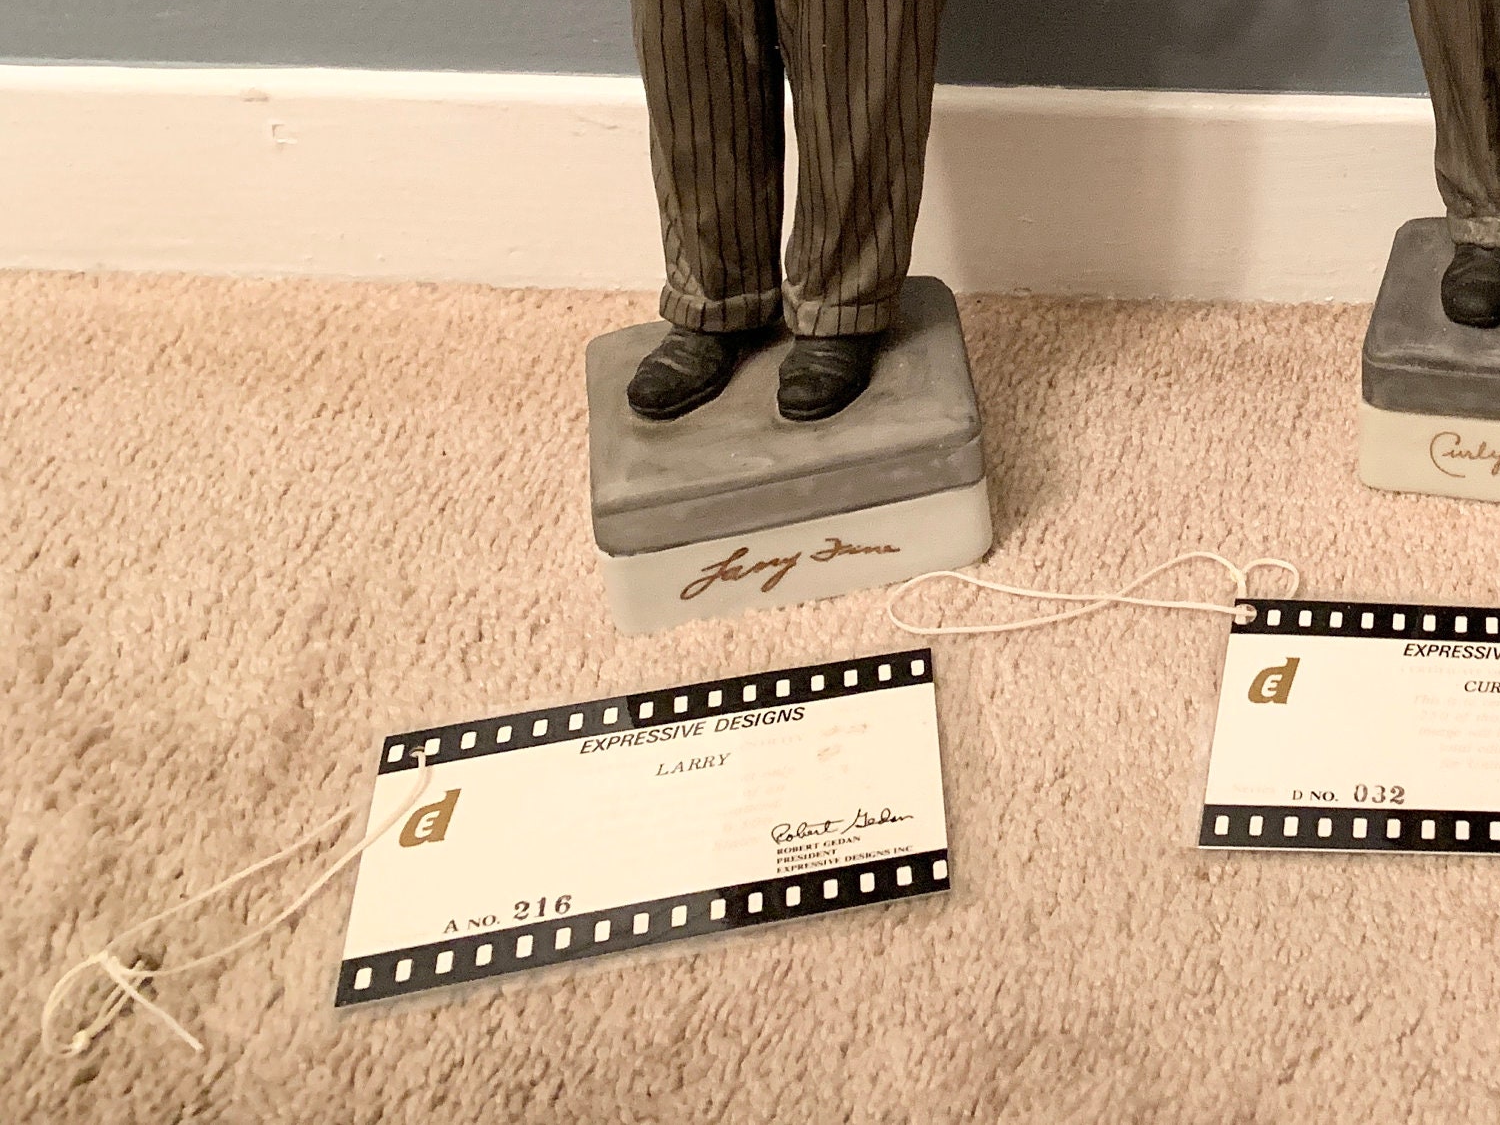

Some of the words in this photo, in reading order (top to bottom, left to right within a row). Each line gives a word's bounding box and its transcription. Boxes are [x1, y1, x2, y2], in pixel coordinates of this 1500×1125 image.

[580, 721, 707, 755] EXPRESSIVE
[715, 705, 806, 734] DESIGNS
[656, 752, 733, 777] LARRY
[1291, 789, 1304, 801] D
[1309, 790, 1340, 803] NO.
[1352, 783, 1406, 806] 032
[776, 842, 820, 855] ROBERT
[823, 835, 862, 849] GEDAN
[776, 848, 839, 865] PRESIDENT
[776, 857, 841, 874] EXPRESSIVE
[844, 848, 892, 863] DESIGNS
[893, 845, 914, 854] INC
[442, 918, 459, 935] A
[466, 913, 501, 930] NO.
[512, 893, 574, 922] 216
